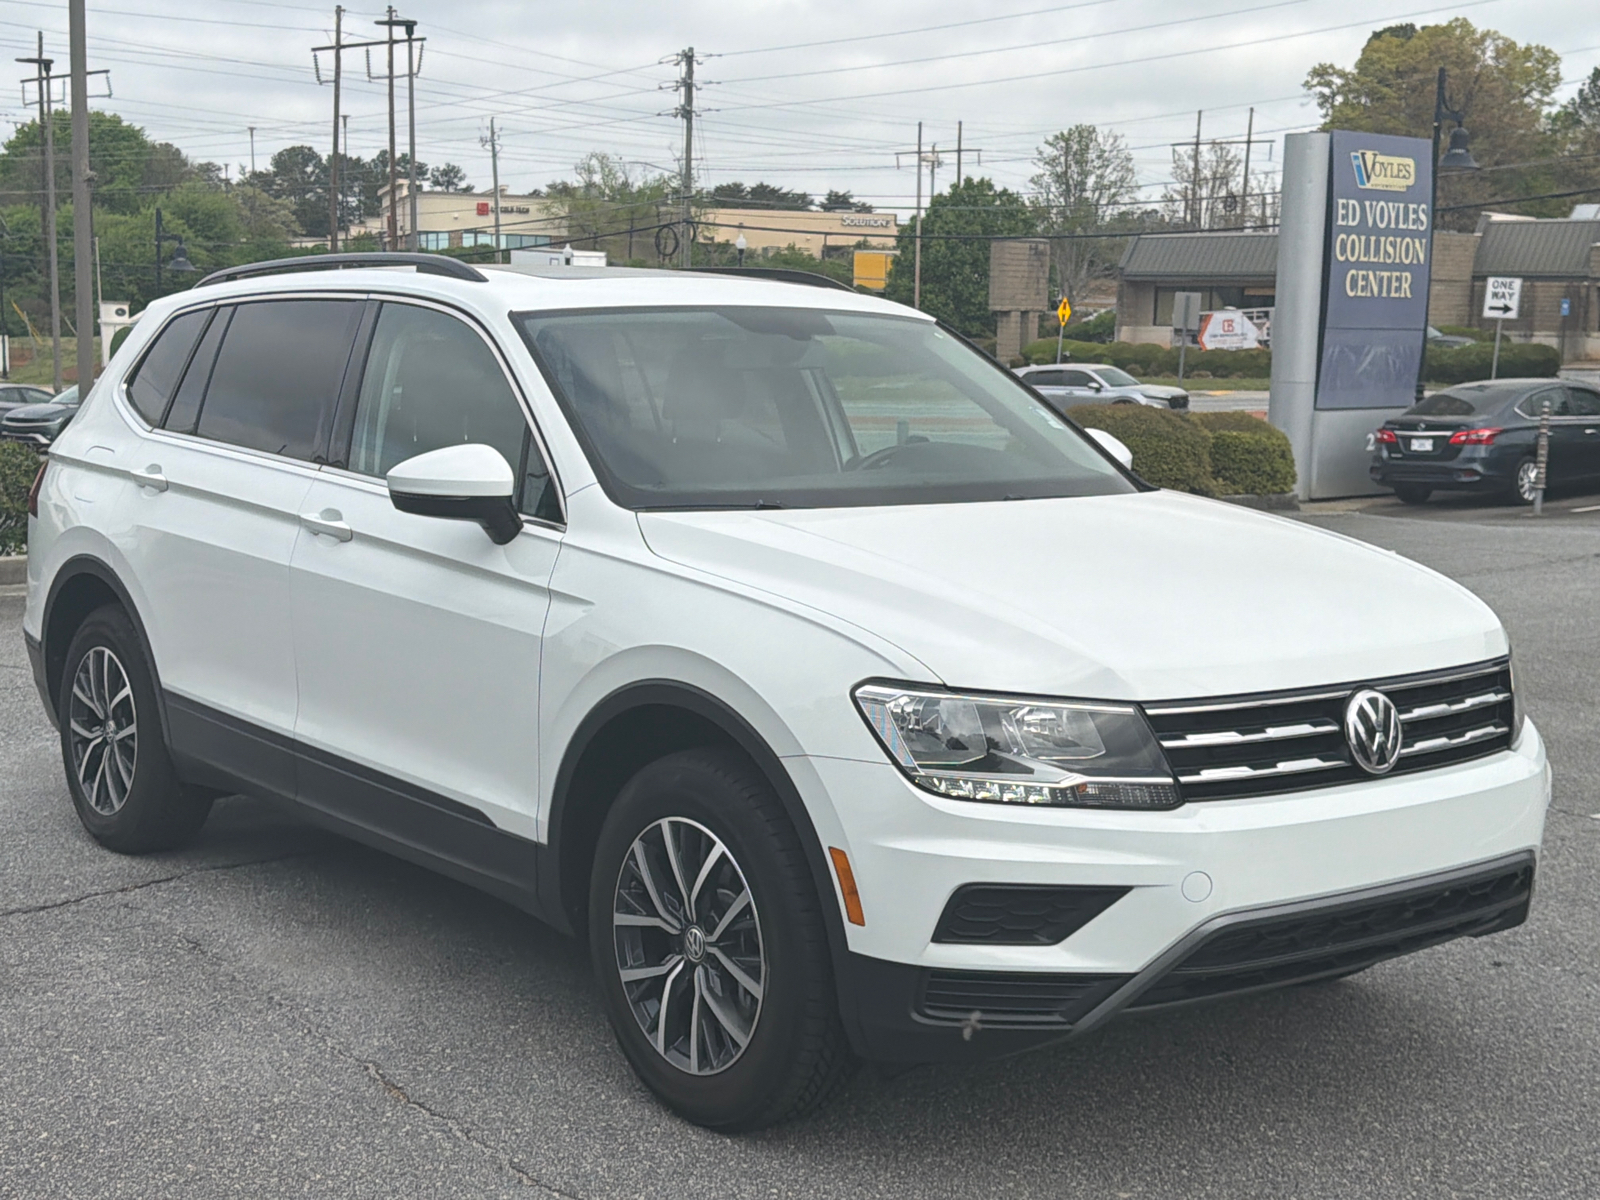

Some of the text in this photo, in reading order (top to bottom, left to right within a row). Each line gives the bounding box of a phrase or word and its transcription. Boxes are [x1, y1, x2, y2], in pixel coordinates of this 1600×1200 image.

[1337, 199, 1428, 231] ED VOYLES
[1335, 234, 1426, 265] COLLISION
[1345, 269, 1412, 298] CENTER
[1491, 291, 1516, 302] WAY
[1492, 280, 1515, 291] ONE
